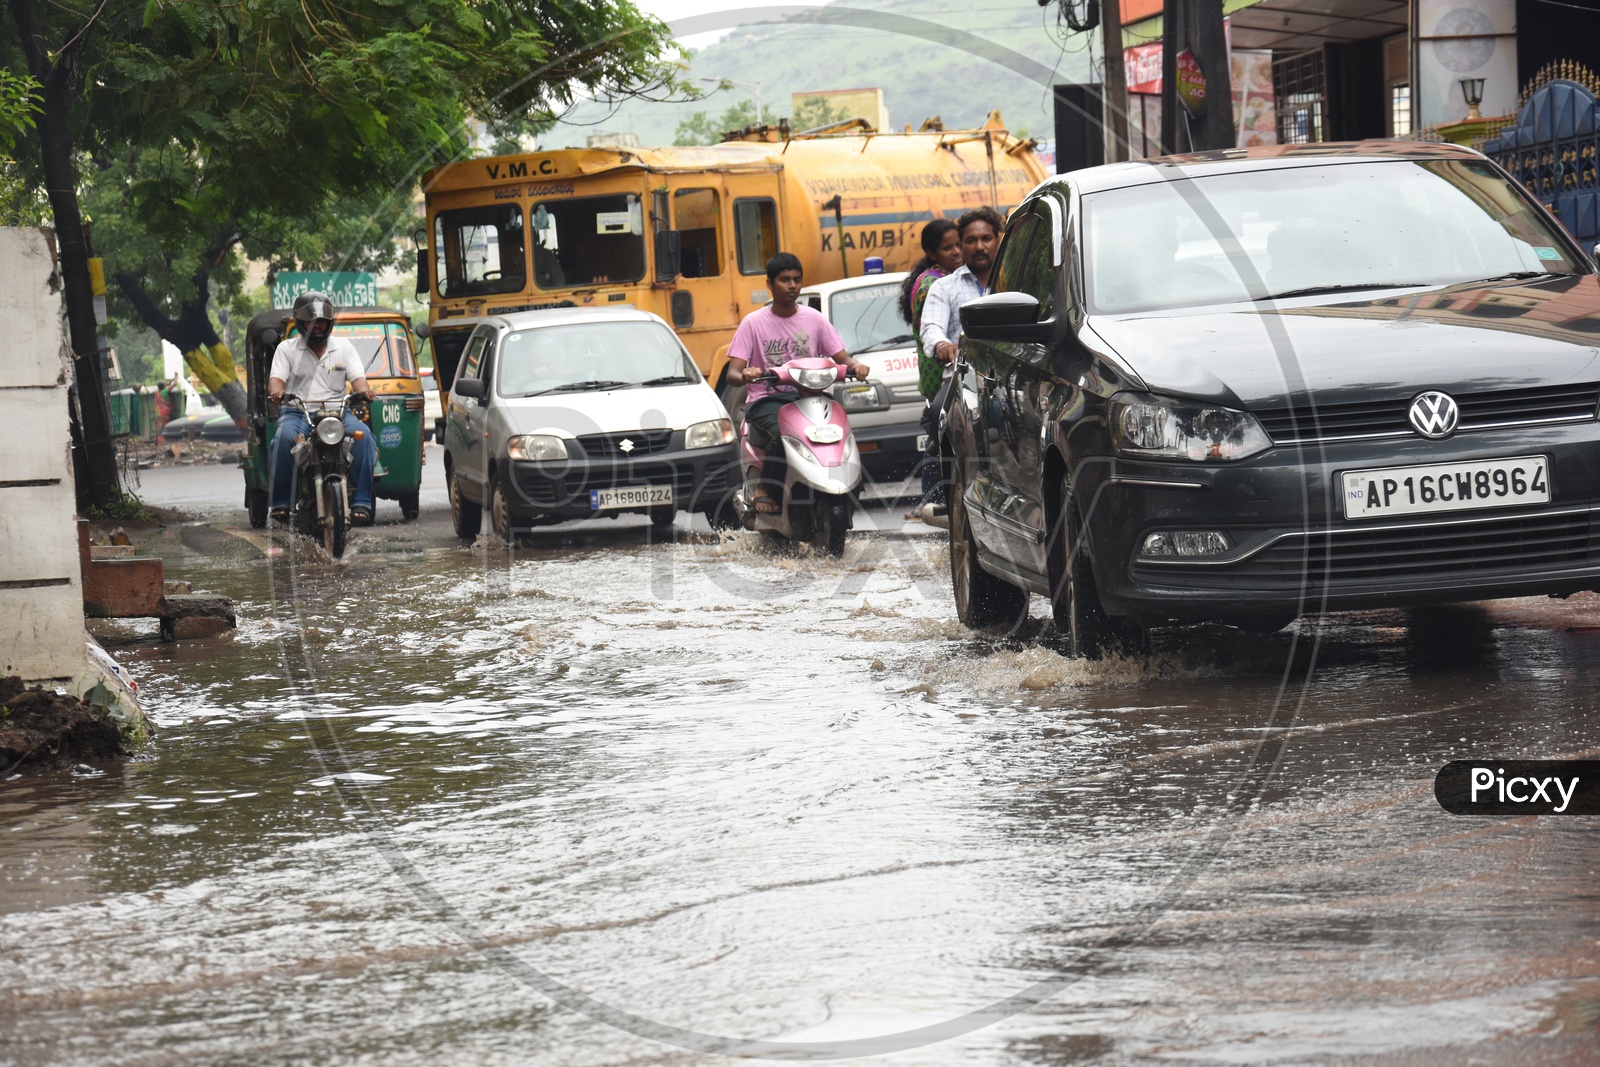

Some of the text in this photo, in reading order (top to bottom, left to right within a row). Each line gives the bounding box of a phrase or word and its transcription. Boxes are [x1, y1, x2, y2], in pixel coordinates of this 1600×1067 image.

[488, 306, 519, 315] ASHOK
[763, 338, 790, 353] Wild
[382, 404, 401, 424] CNG
[380, 432, 401, 443] 2895
[1348, 465, 1546, 508] IND AP16CW8964
